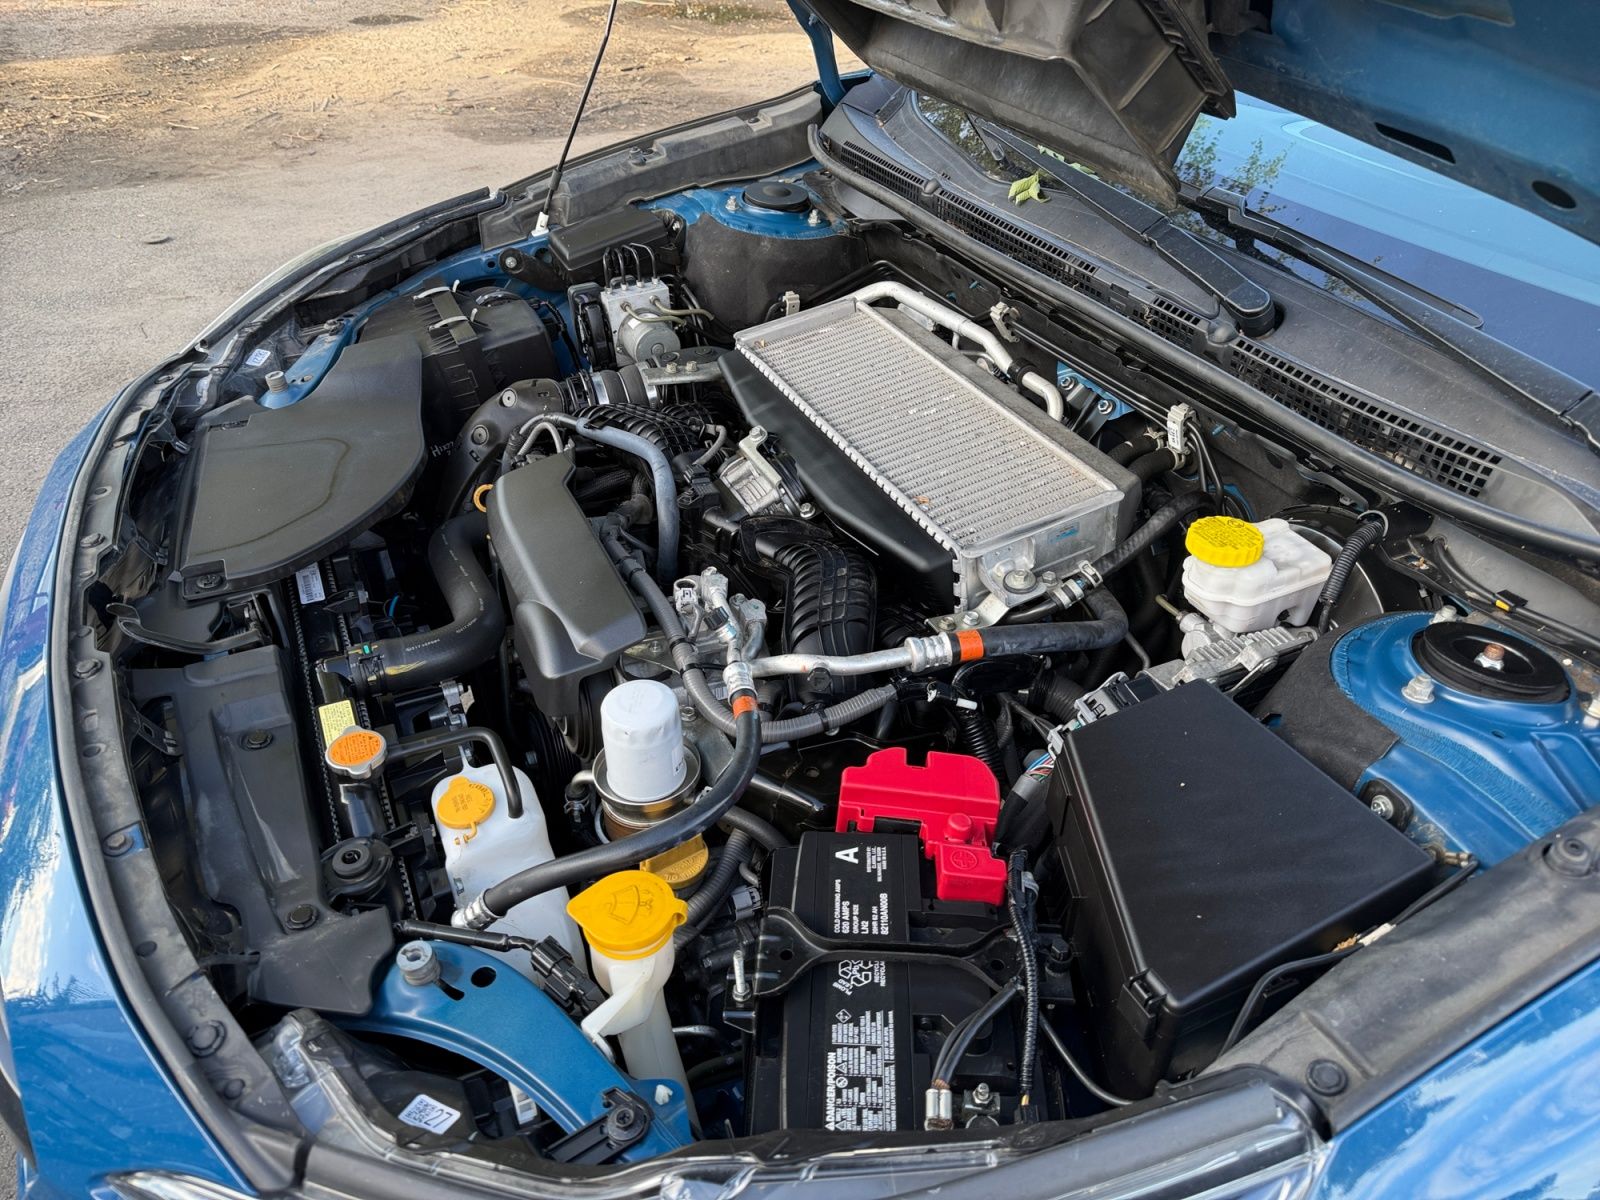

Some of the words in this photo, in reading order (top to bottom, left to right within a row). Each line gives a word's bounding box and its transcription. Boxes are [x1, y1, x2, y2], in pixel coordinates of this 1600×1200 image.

[835, 847, 858, 864] A
[826, 1052, 836, 1122] DANGER/POISON
[424, 1108, 453, 1128] 27
